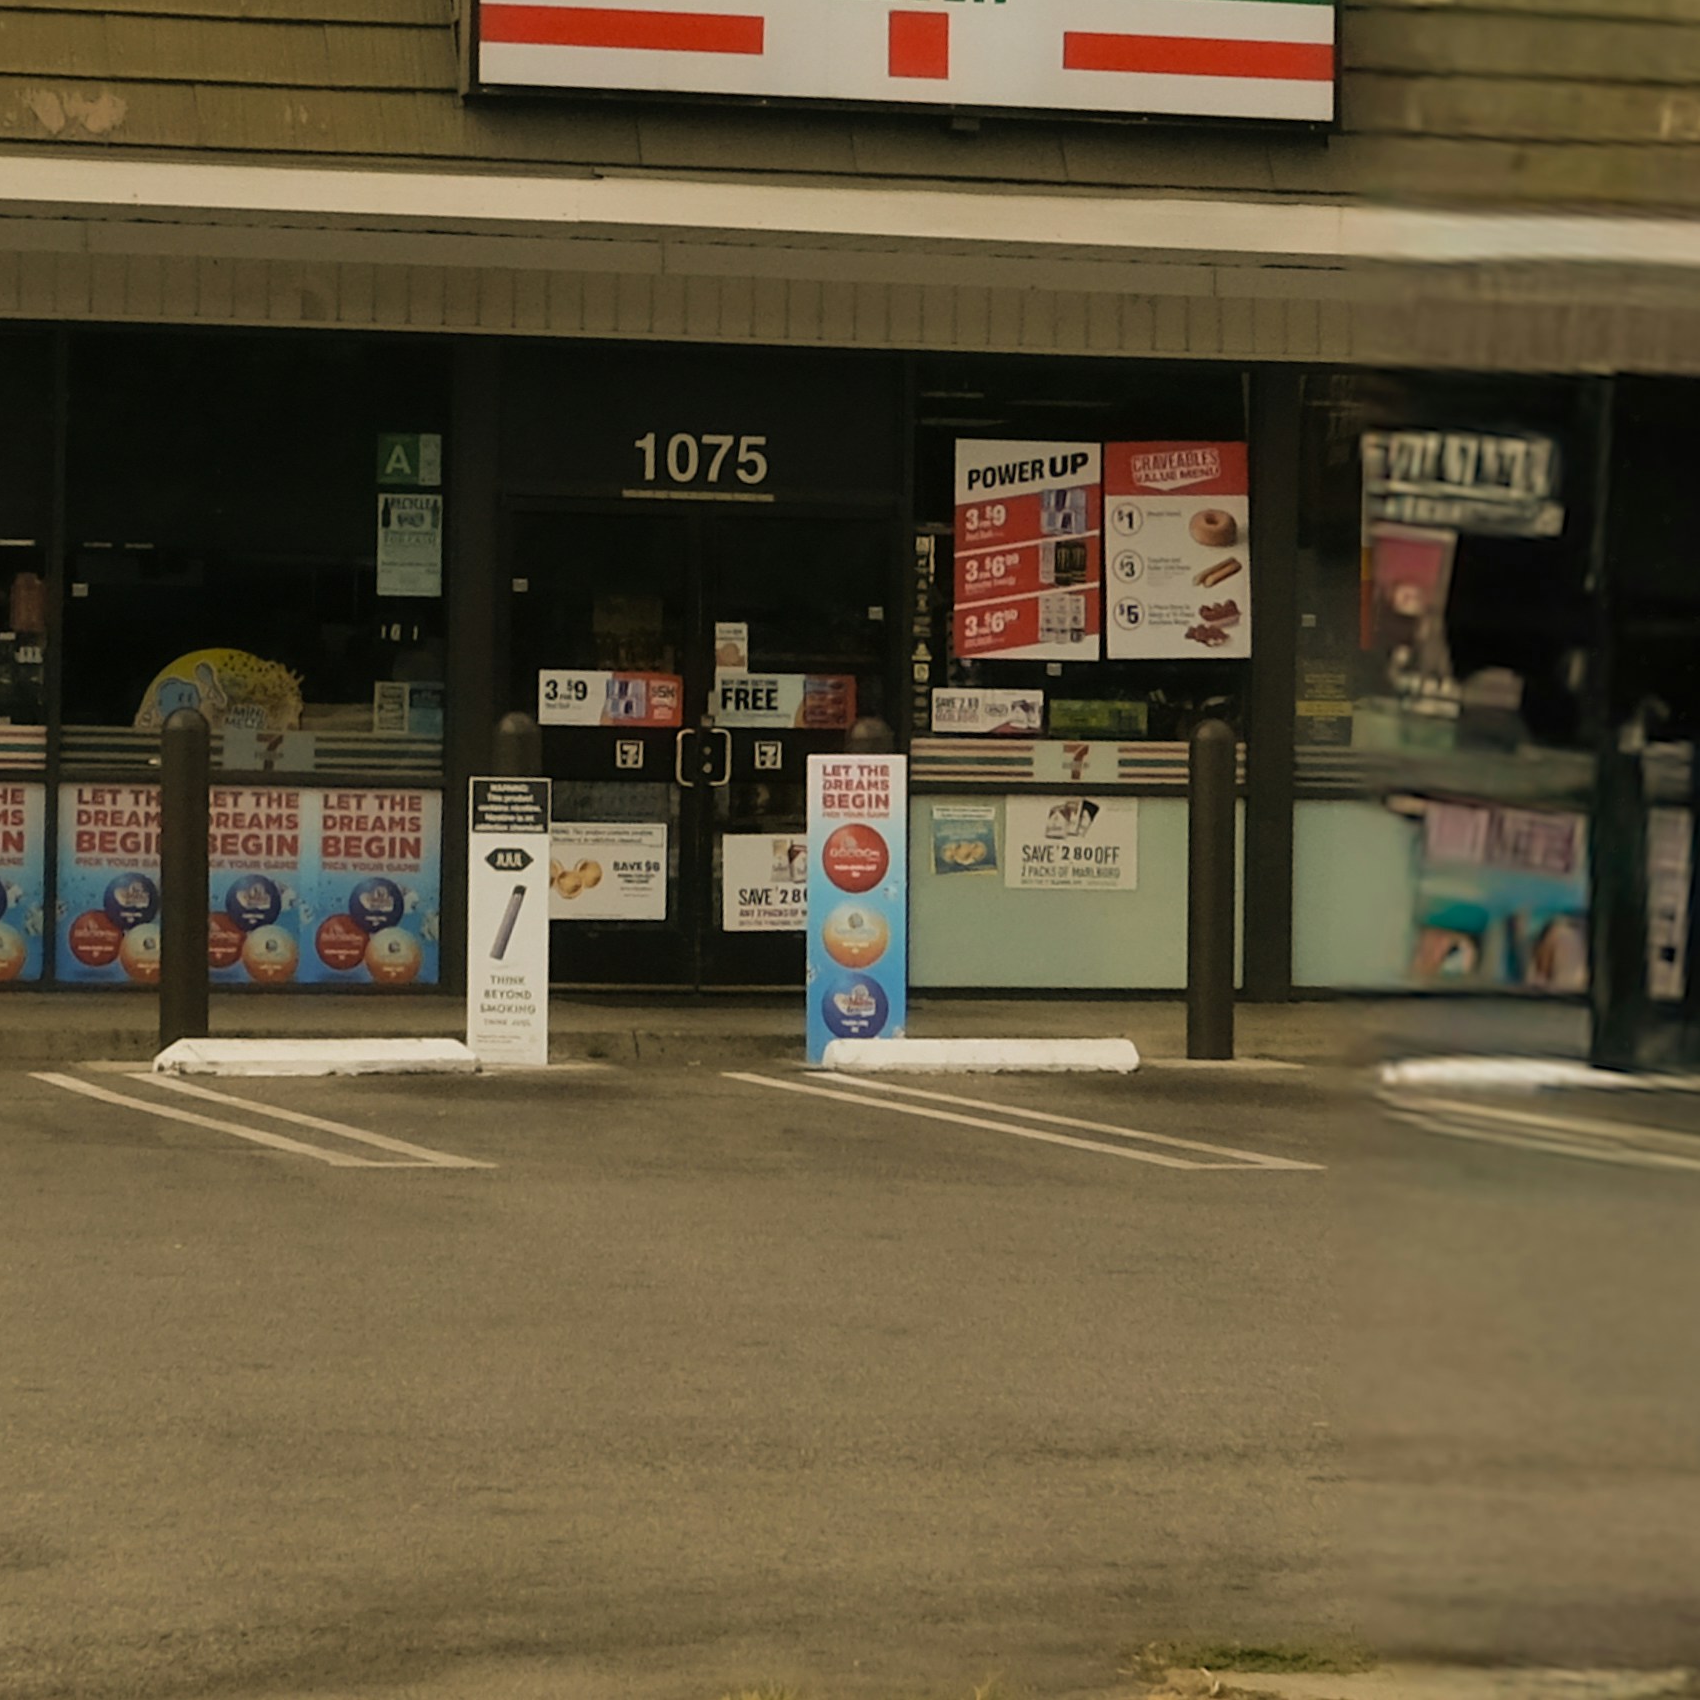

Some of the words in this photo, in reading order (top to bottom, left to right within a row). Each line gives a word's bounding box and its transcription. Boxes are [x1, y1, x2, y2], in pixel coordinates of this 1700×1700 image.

[385, 444, 411, 474] A
[634, 432, 768, 484] 1075
[967, 458, 1044, 490] POWER
[1049, 452, 1089, 478] UP
[721, 688, 778, 710] FREE
[822, 764, 851, 776] LET
[857, 764, 889, 777] THE
[822, 779, 889, 791] DREAMS
[77, 788, 122, 805] LET
[129, 789, 162, 806] TH
[211, 791, 243, 807] ET
[251, 792, 299, 809] THE
[323, 793, 367, 810] LET
[374, 794, 422, 812] THE
[822, 793, 889, 809] BEGIN
[76, 809, 162, 828] DREAM
[322, 814, 421, 833] DREAMS
[321, 836, 420, 859] BEGIN
[1022, 844, 1054, 863] SAVE
[1095, 846, 1120, 864] OFF
[738, 888, 772, 906] SAVE
[484, 989, 532, 1000] BEYOND
[480, 1003, 536, 1015] SMOKING
